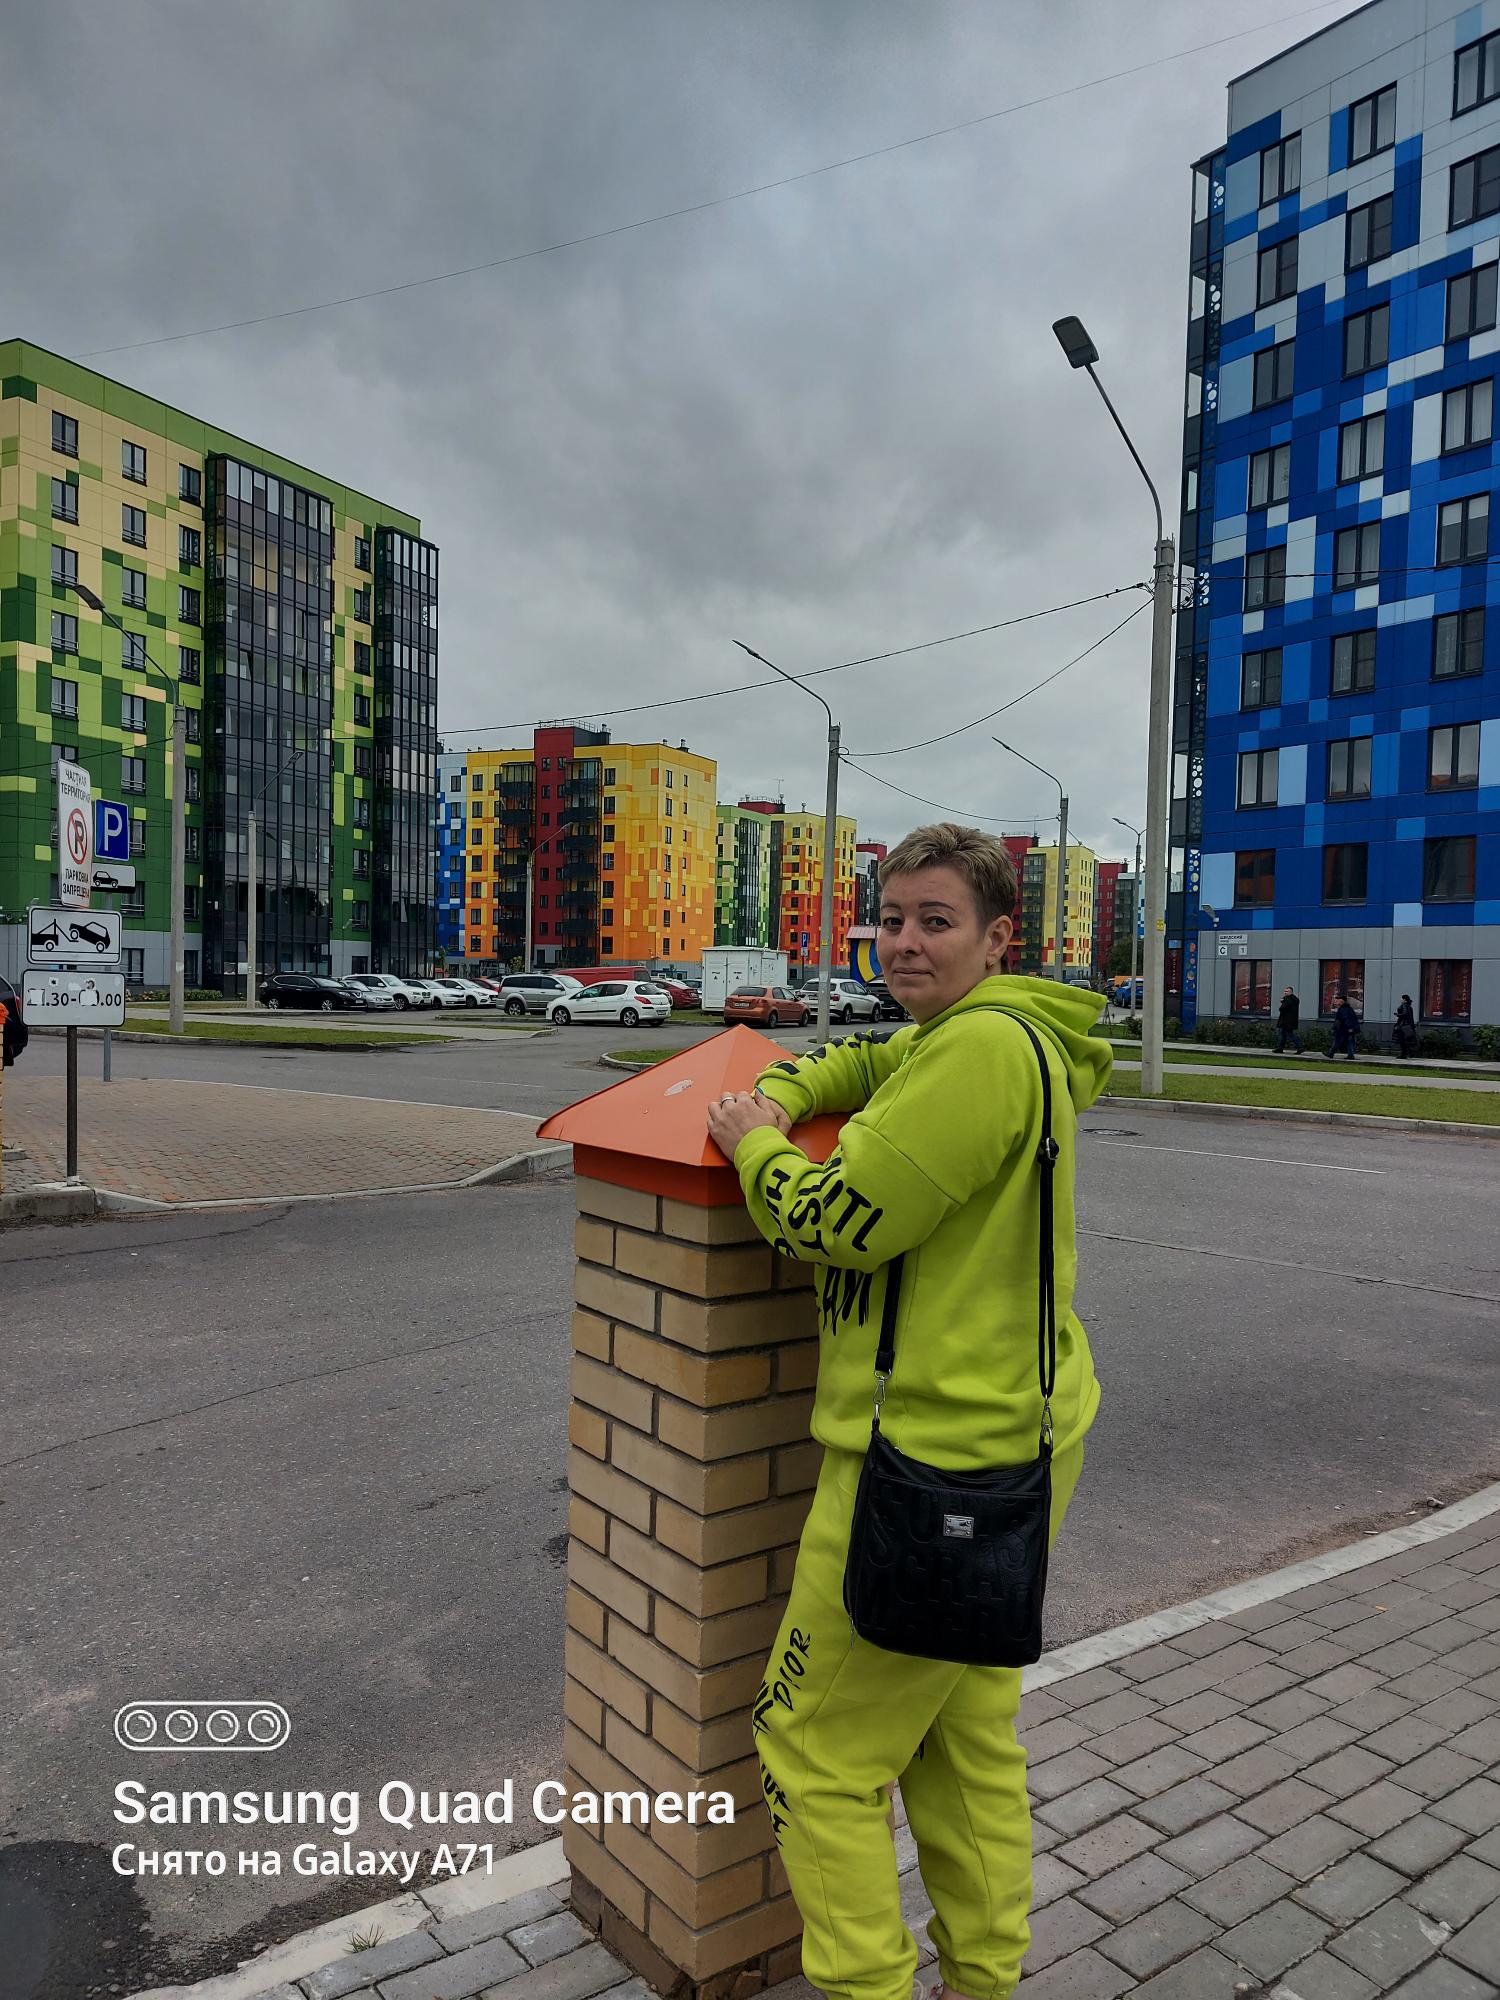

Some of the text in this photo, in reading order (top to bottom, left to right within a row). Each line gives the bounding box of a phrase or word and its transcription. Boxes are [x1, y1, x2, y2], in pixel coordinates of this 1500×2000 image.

[104, 807, 122, 851] P
[63, 882, 90, 899] ЗАПРЕЩЕНА
[65, 868, 89, 883] ПАРКОВКА
[773, 1627, 811, 1712] DIOR
